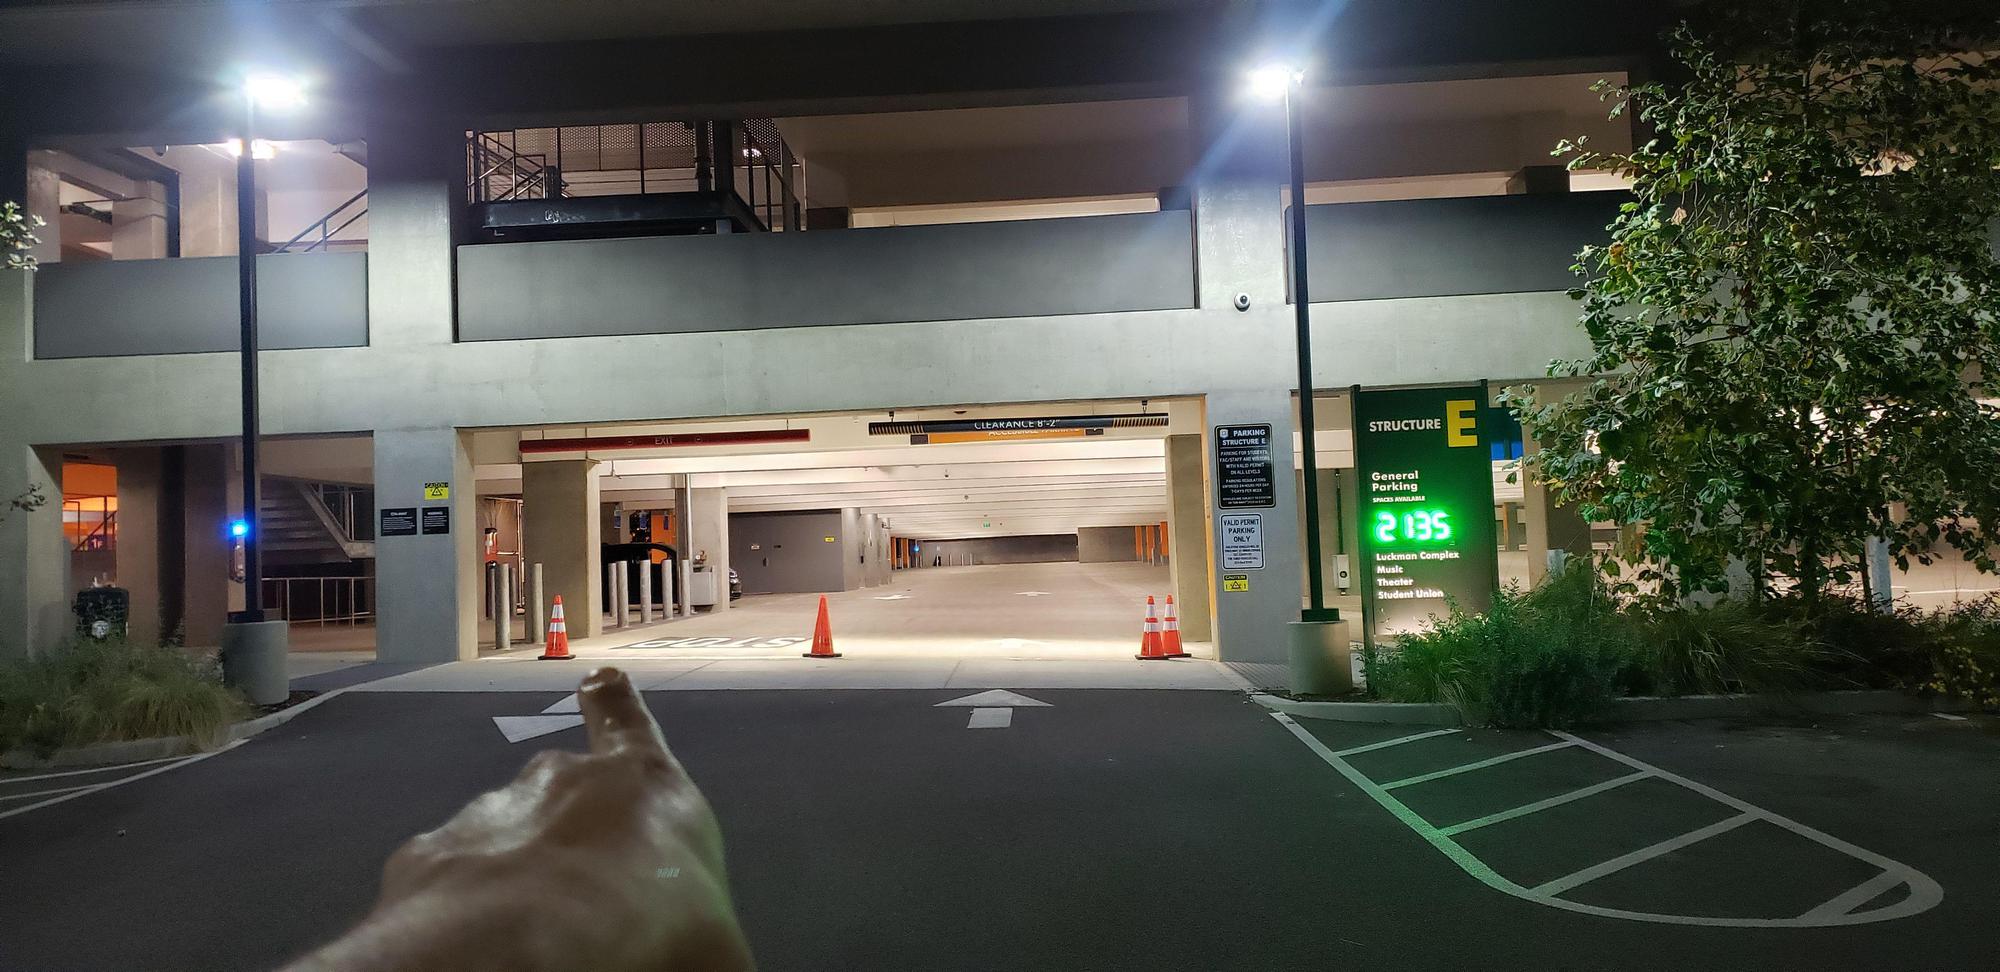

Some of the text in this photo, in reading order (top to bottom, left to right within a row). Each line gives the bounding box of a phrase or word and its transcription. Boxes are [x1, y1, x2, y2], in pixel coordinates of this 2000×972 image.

[974, 420, 1037, 430] CLEARANCE
[1369, 400, 1478, 447] STRUCTURE E
[1233, 429, 1266, 437] PARKING
[655, 436, 673, 445] EXIT
[1222, 438, 1259, 446] STRUCTURE
[1371, 470, 1419, 481] General
[1372, 481, 1418, 492] Parking
[1375, 510, 1451, 542] 2135
[1376, 550, 1460, 561] Luckman Complex
[1377, 565, 1404, 574] Music
[1377, 578, 1414, 587] Theater
[1378, 589, 1444, 600] Student Union
